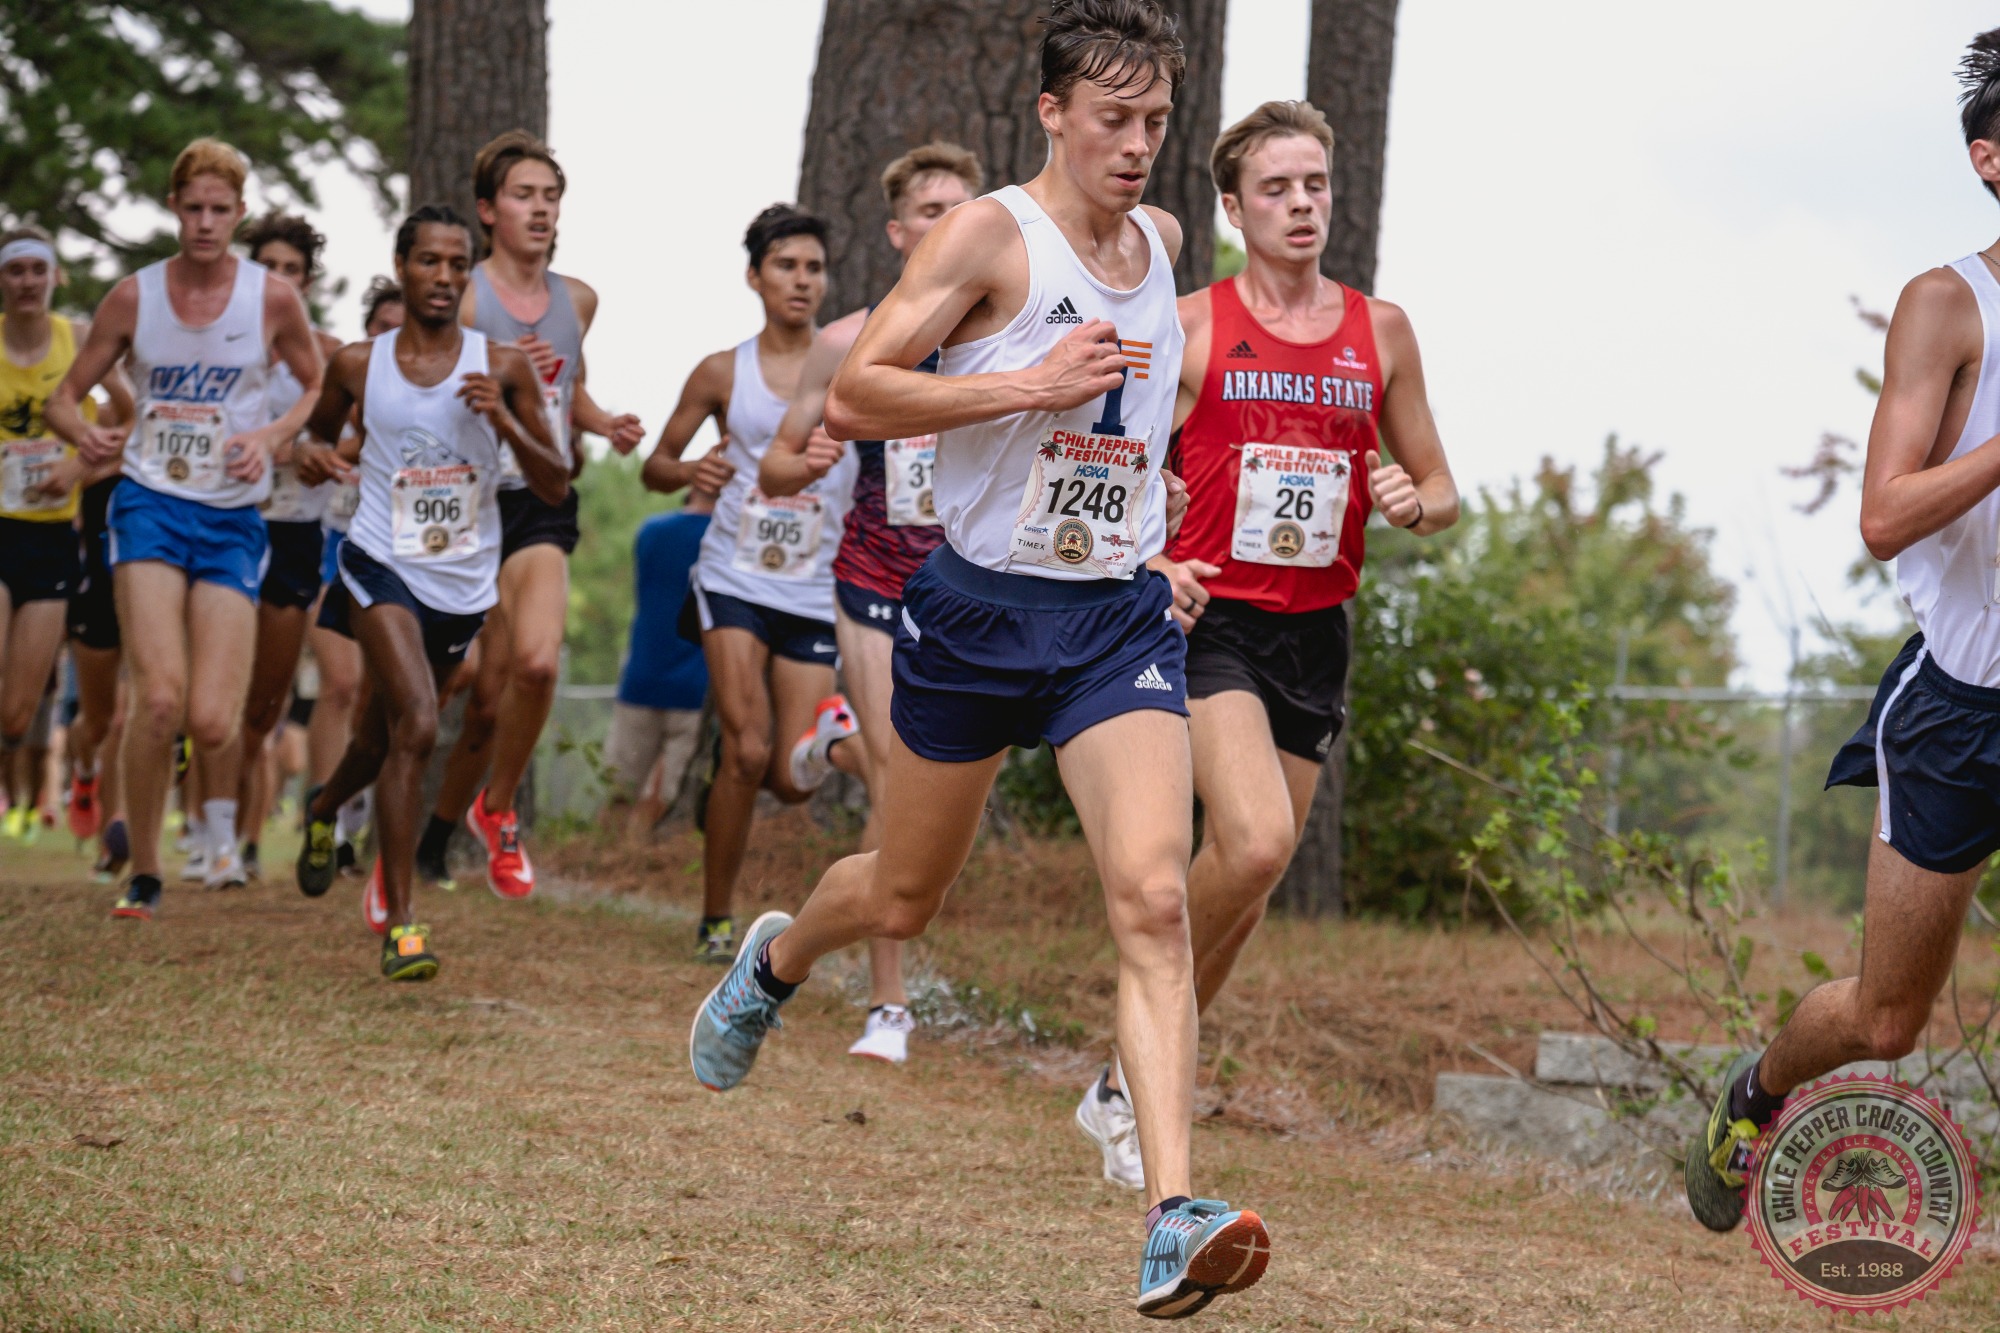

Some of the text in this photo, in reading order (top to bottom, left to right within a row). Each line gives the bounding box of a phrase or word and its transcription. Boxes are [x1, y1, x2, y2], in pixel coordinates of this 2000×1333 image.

[1045, 313, 1084, 325] adidas
[1226, 351, 1258, 359] adidas
[149, 363, 242, 403] UAH
[1222, 370, 1374, 411] ARKANSAS STATE
[156, 431, 211, 457] 1079
[1052, 430, 1146, 456] CHILE PEPPER
[1064, 447, 1130, 467] FESTIVAL
[1254, 447, 1293, 461] CHILE
[1073, 464, 1110, 480] HOKA
[1266, 460, 1330, 475] FESTIVAL
[1279, 474, 1315, 487] HOKA
[1047, 477, 1127, 523] 1248
[1274, 488, 1315, 521] 26
[413, 497, 462, 525] 906
[758, 518, 802, 546] 905
[1017, 538, 1046, 551] TIMEX
[1134, 679, 1173, 692] adidas
